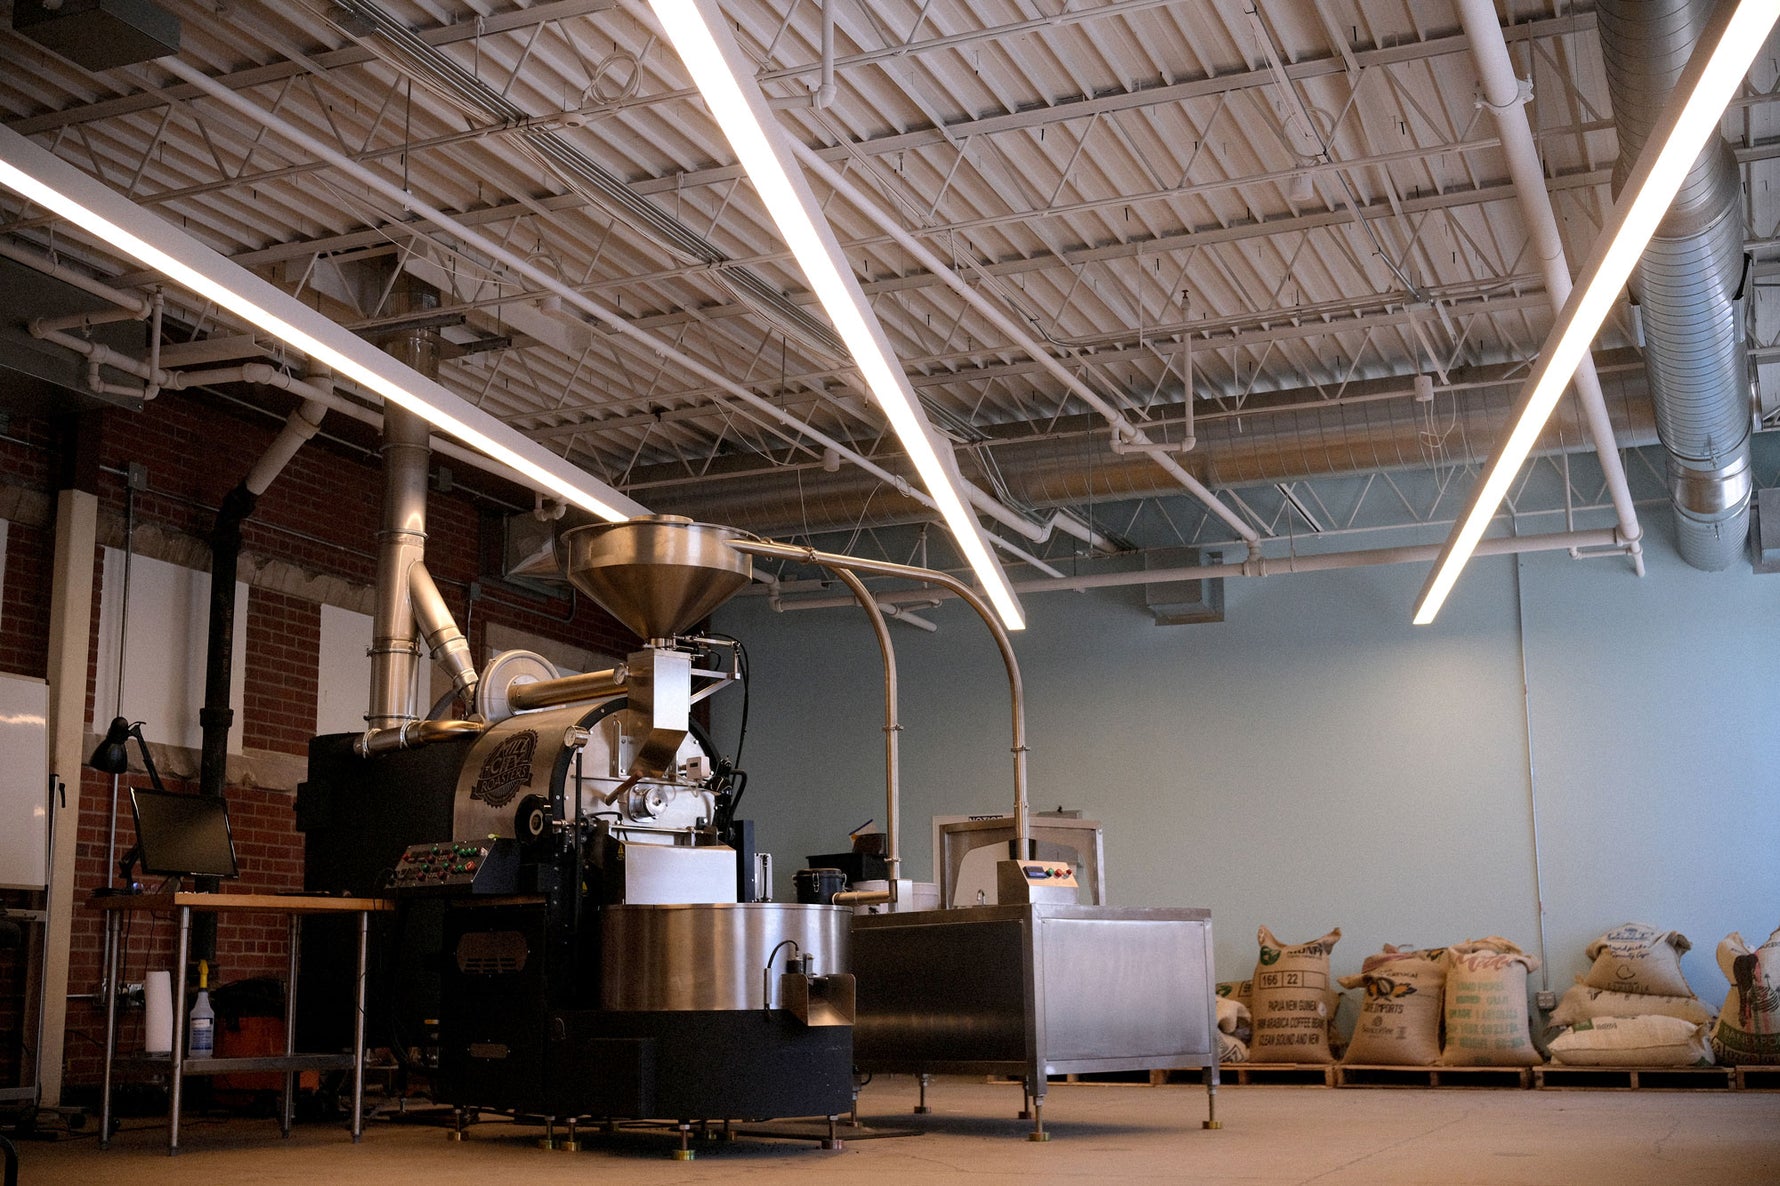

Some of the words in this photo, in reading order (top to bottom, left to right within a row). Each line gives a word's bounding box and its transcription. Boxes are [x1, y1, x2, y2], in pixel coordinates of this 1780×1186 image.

[491, 754, 522, 774] CITY
[481, 765, 528, 792] ROASTERS
[1286, 973, 1298, 985] 22
[1290, 1017, 1311, 1028] COFFEE
